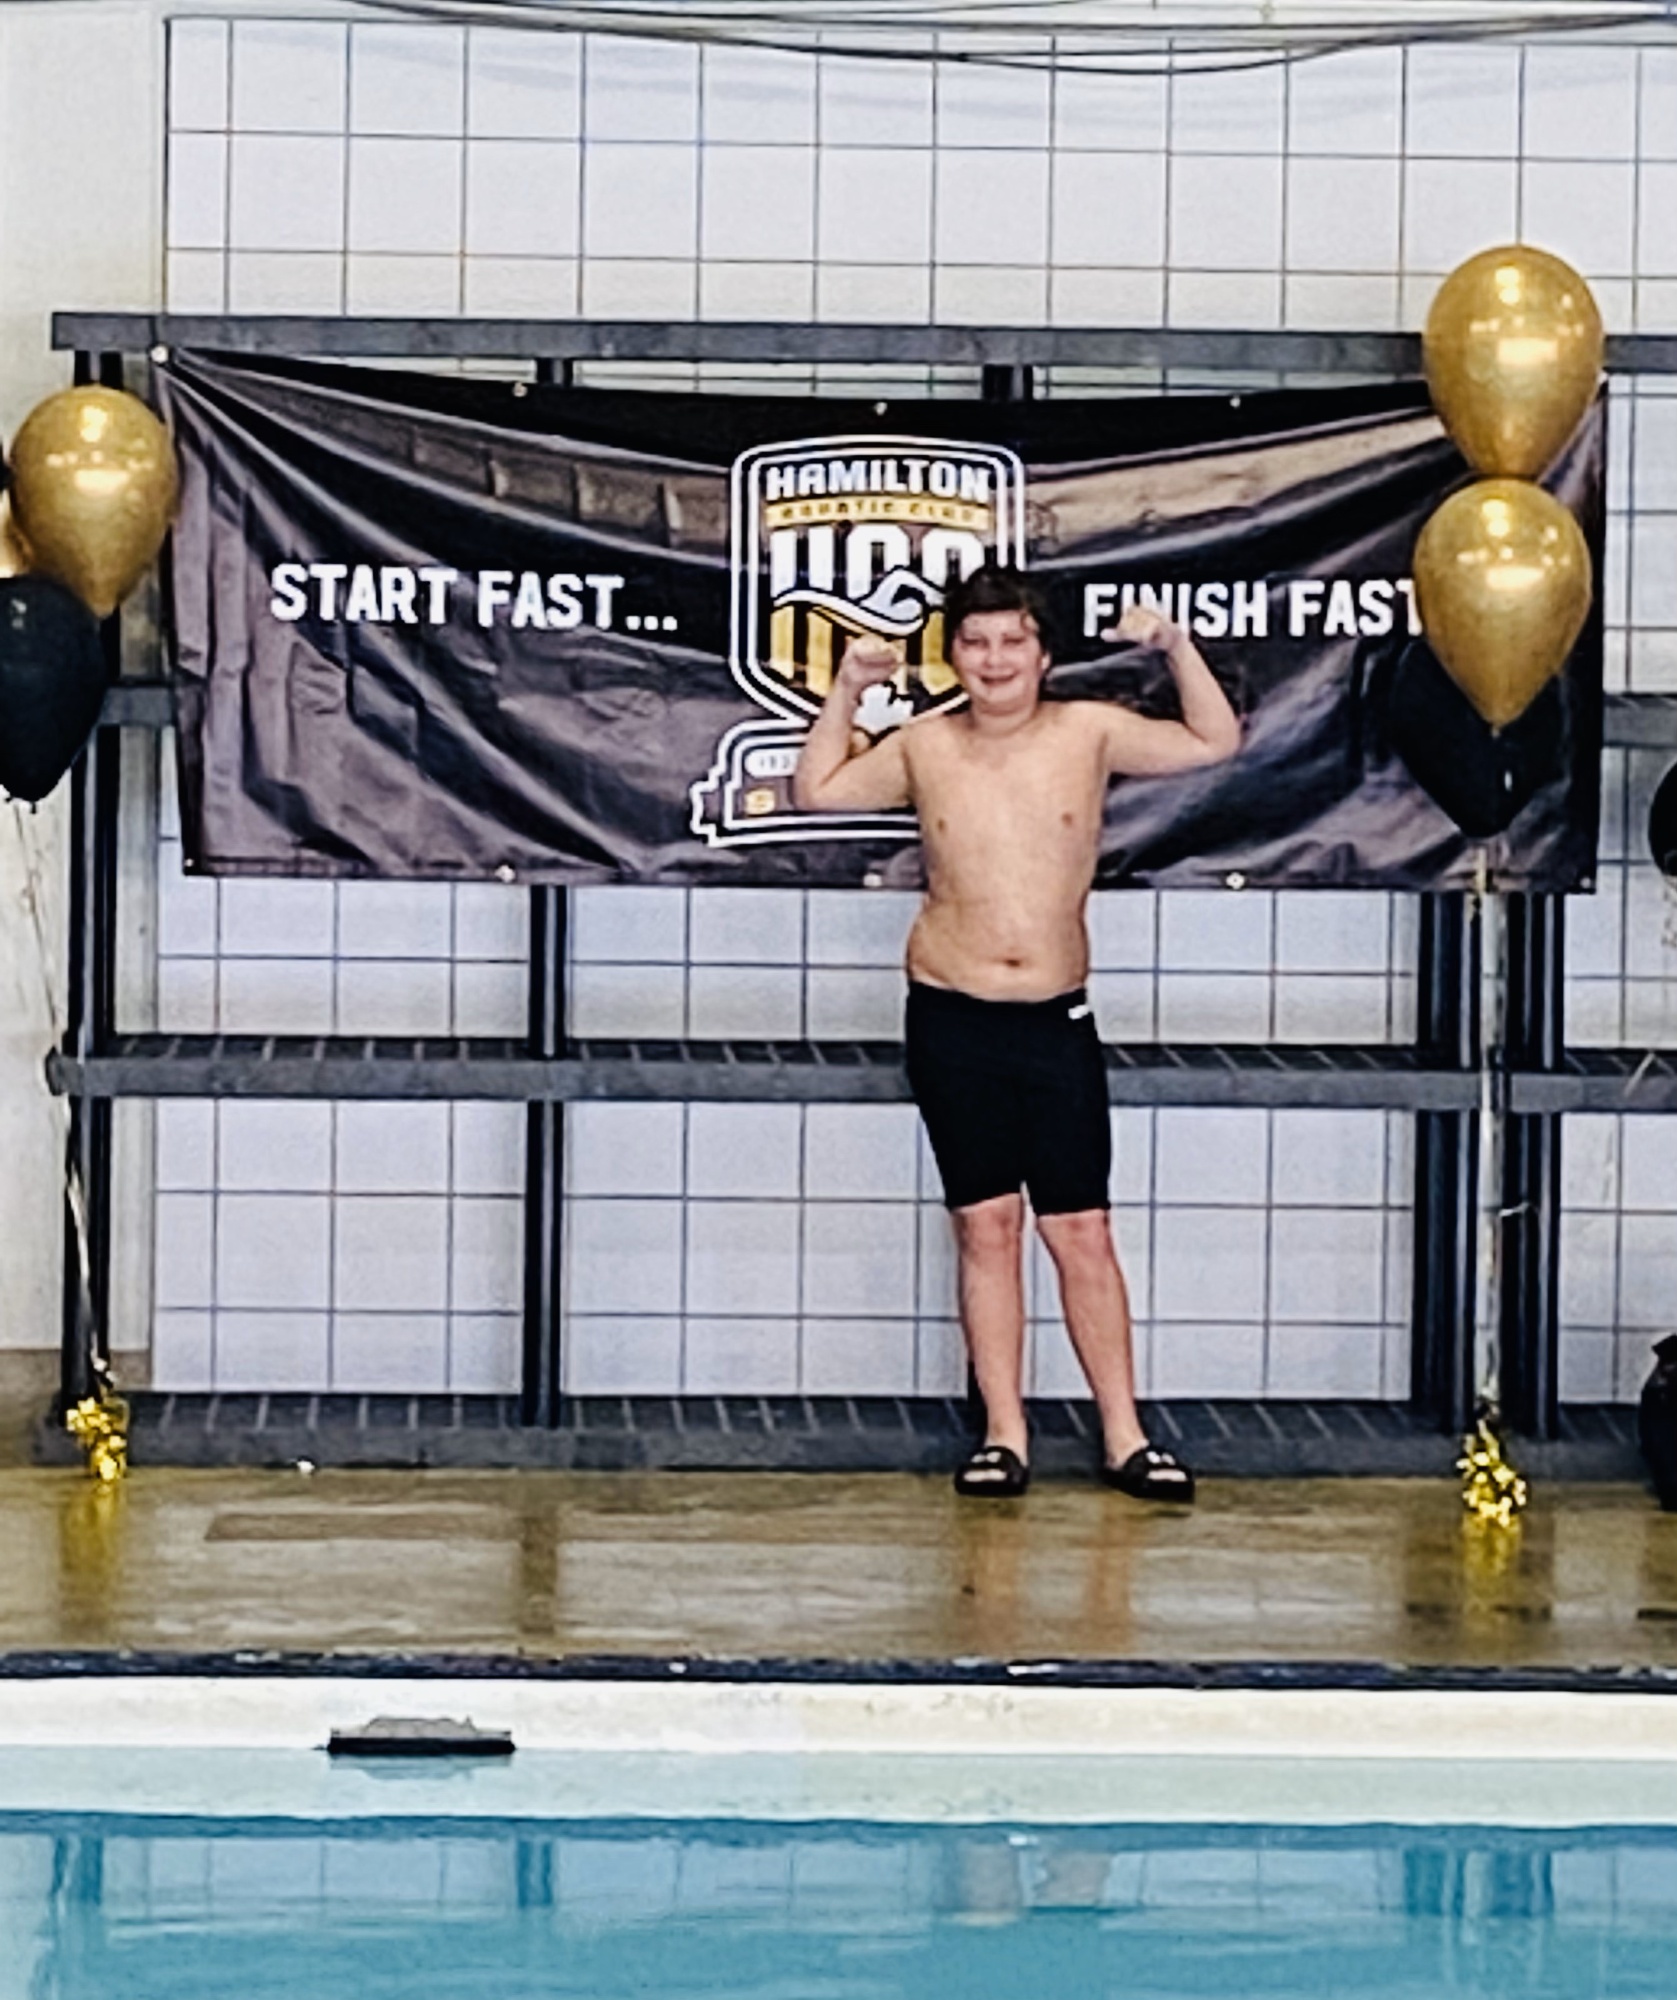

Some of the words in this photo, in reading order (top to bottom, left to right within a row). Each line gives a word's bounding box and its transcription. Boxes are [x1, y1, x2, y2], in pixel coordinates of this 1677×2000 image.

[766, 458, 991, 501] HAMILTON
[271, 562, 458, 624] START
[477, 570, 678, 630] FAST...
